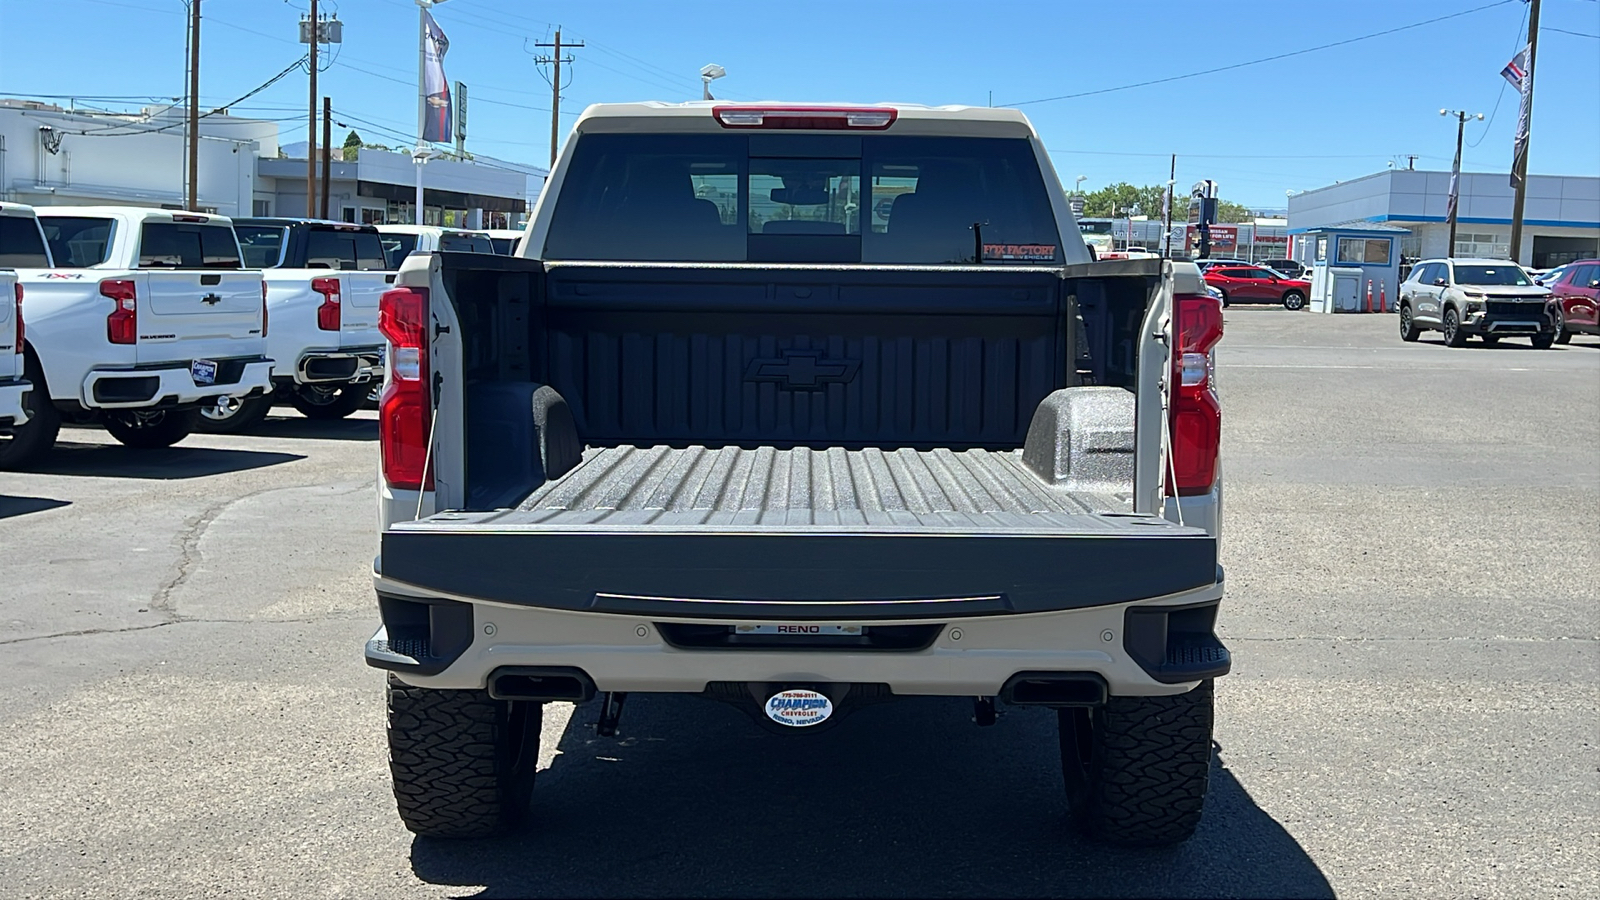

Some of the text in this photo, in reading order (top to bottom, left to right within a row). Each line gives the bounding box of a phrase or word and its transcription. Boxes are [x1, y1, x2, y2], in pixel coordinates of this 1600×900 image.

[1007, 245, 1056, 255] FACTORY
[777, 625, 820, 633] RENO
[770, 697, 828, 710] CHAMPION
[772, 714, 826, 725] RENO, NEVADA
